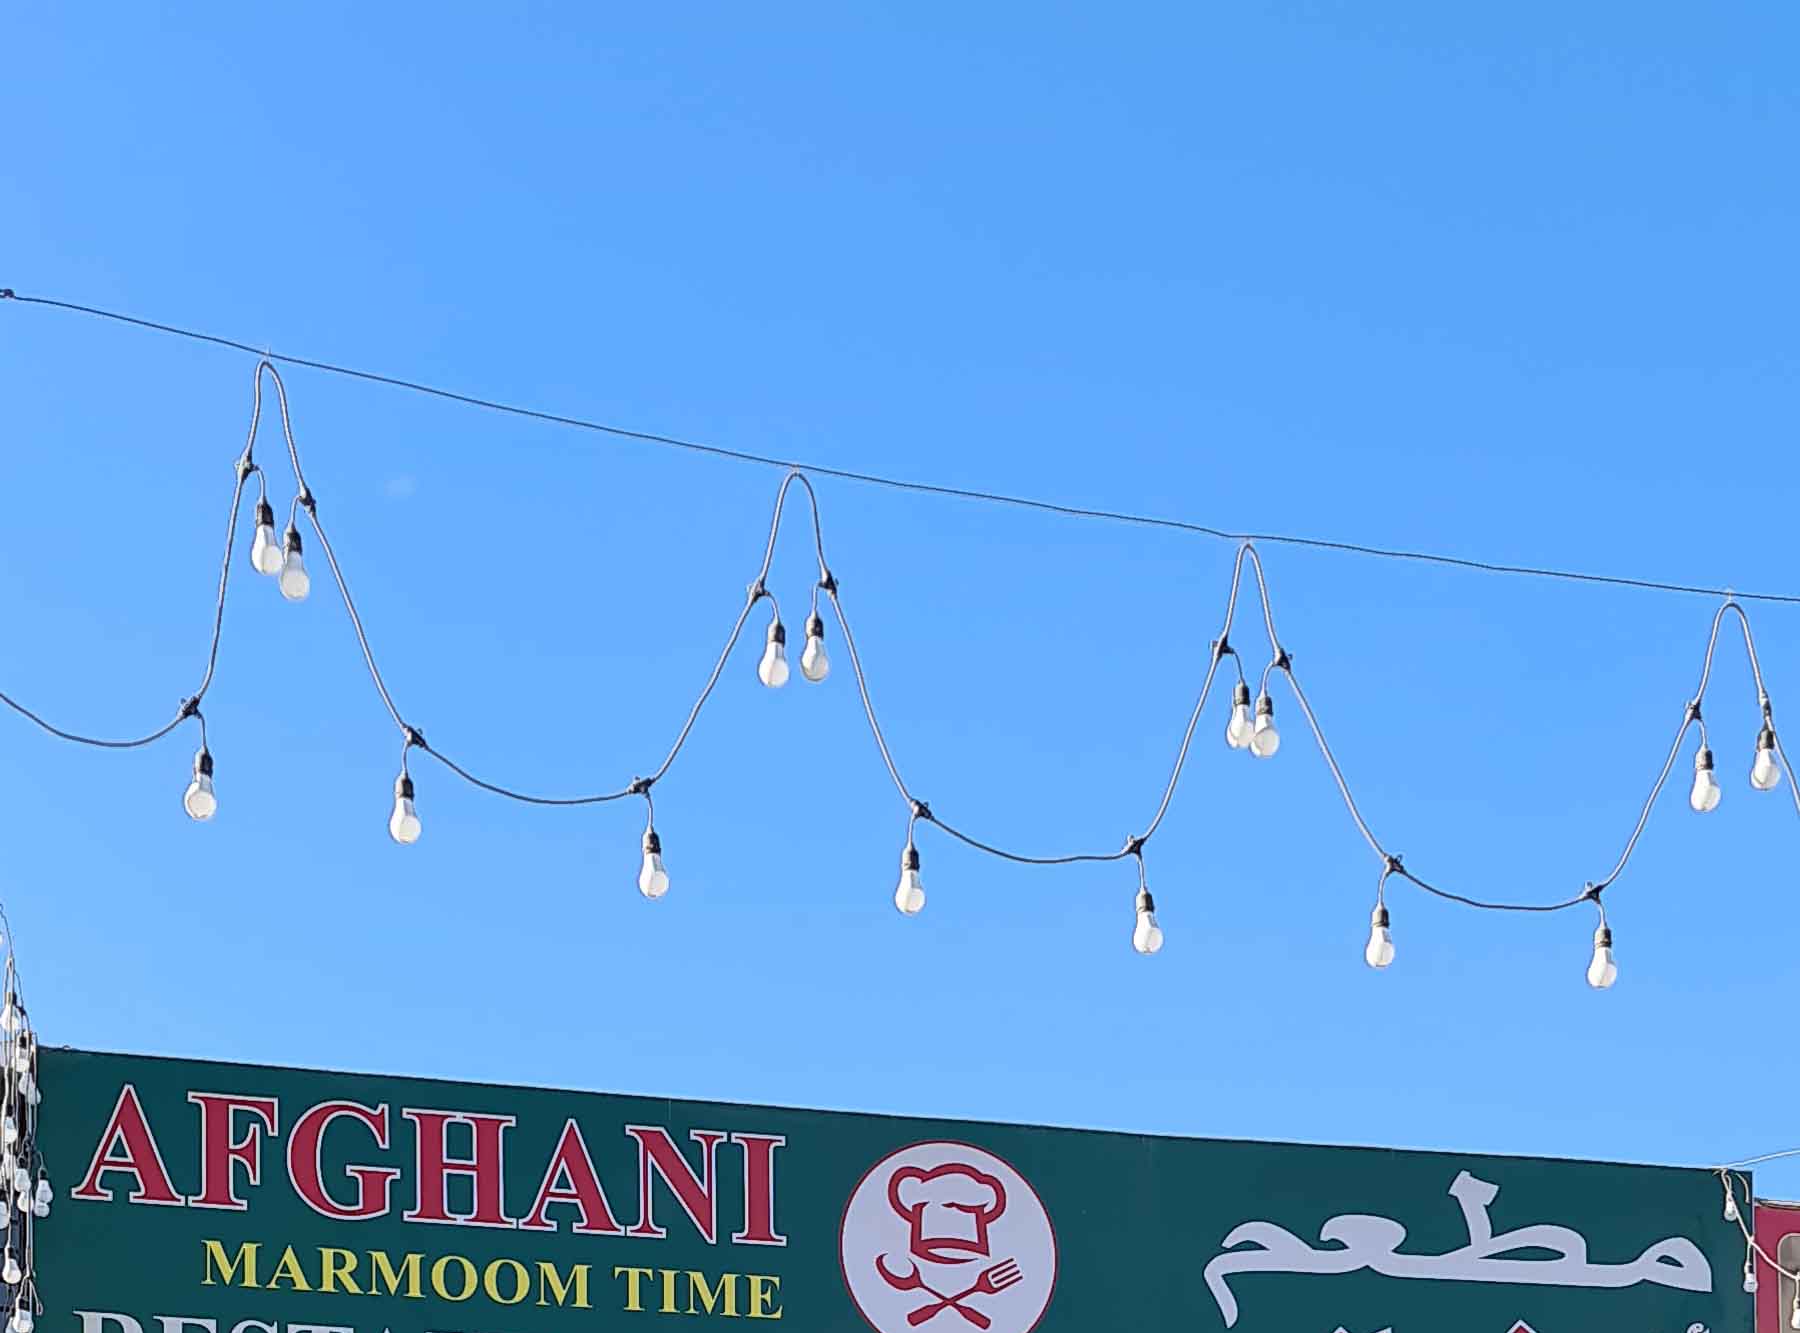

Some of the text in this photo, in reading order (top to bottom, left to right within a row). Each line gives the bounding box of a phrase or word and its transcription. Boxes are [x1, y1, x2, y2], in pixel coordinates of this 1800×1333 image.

[71, 1083, 787, 1247] AFGHANI
[200, 1239, 783, 1319] MARMOOM TIME
[1203, 1169, 1713, 1329] مطعم
